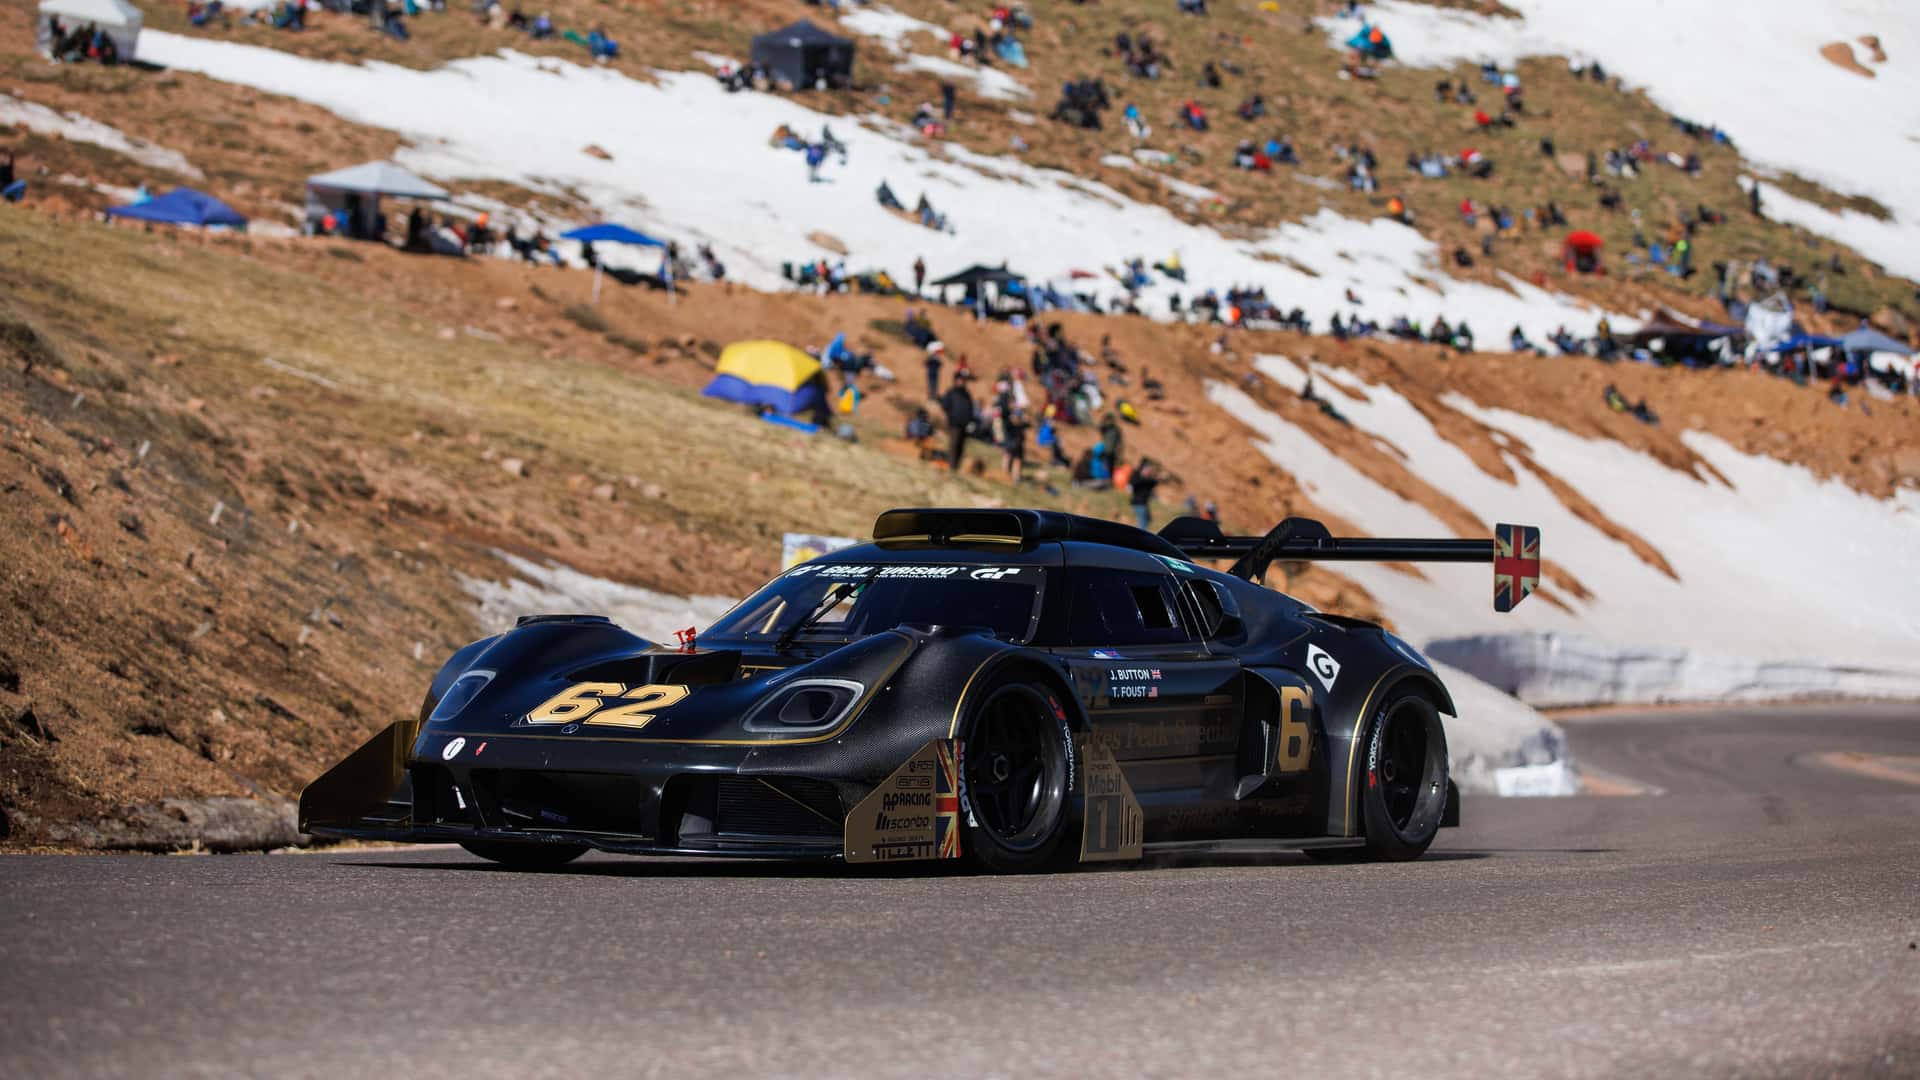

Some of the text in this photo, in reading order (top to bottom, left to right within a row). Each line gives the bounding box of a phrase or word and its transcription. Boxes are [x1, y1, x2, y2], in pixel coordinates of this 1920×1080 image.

[821, 566, 875, 574] GRAN
[1111, 669, 1150, 680] J. BUTTON
[1313, 653, 1334, 680] G
[1112, 686, 1146, 698] T. FOUST
[526, 681, 691, 729] 62
[1278, 685, 1313, 772] 6
[1088, 774, 1121, 794] Mobil
[899, 793, 931, 806] RACING
